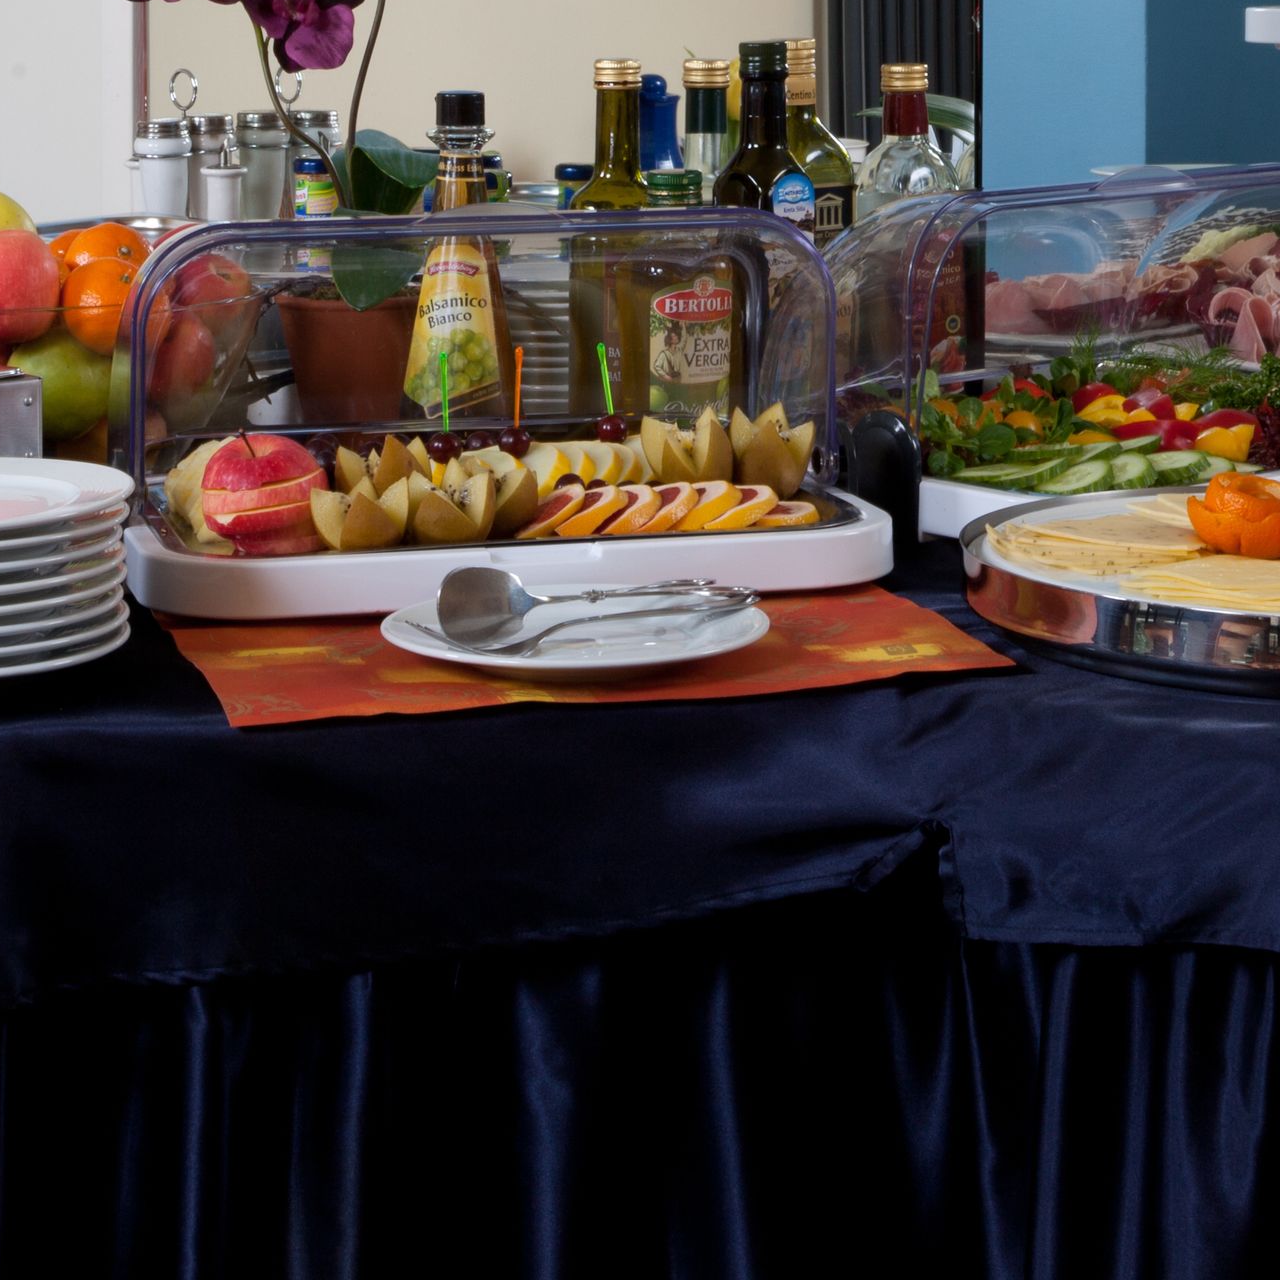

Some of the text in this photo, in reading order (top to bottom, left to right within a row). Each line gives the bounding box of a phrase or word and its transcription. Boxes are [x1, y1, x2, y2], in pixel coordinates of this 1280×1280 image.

[419, 292, 488, 319] Balsamico
[428, 311, 472, 329] Bianco
[694, 337, 730, 352] EXTRA
